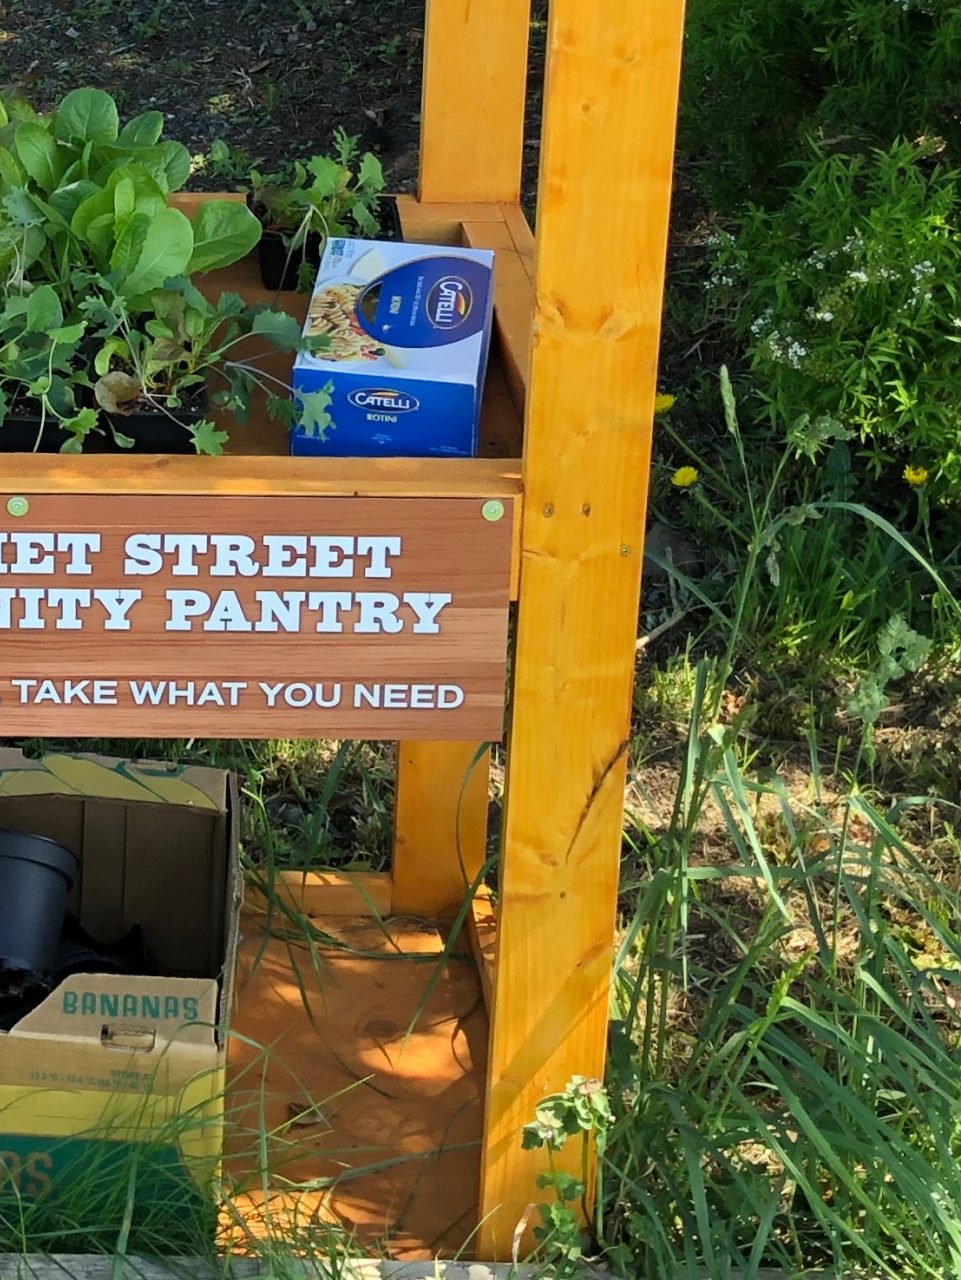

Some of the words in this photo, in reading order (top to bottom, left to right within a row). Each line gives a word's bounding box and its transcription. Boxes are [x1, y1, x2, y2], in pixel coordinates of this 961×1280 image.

[434, 281, 463, 323] CATELLI
[355, 392, 410, 409] CATELLI
[366, 413, 398, 423] ROTINI
[123, 533, 402, 579] STREET
[165, 589, 452, 635] PANTRY
[11, 679, 118, 705] TAKE
[128, 680, 247, 707] WHAT
[258, 682, 342, 709] YOU
[354, 684, 464, 709] NEED
[62, 991, 199, 1021] BANANAS
